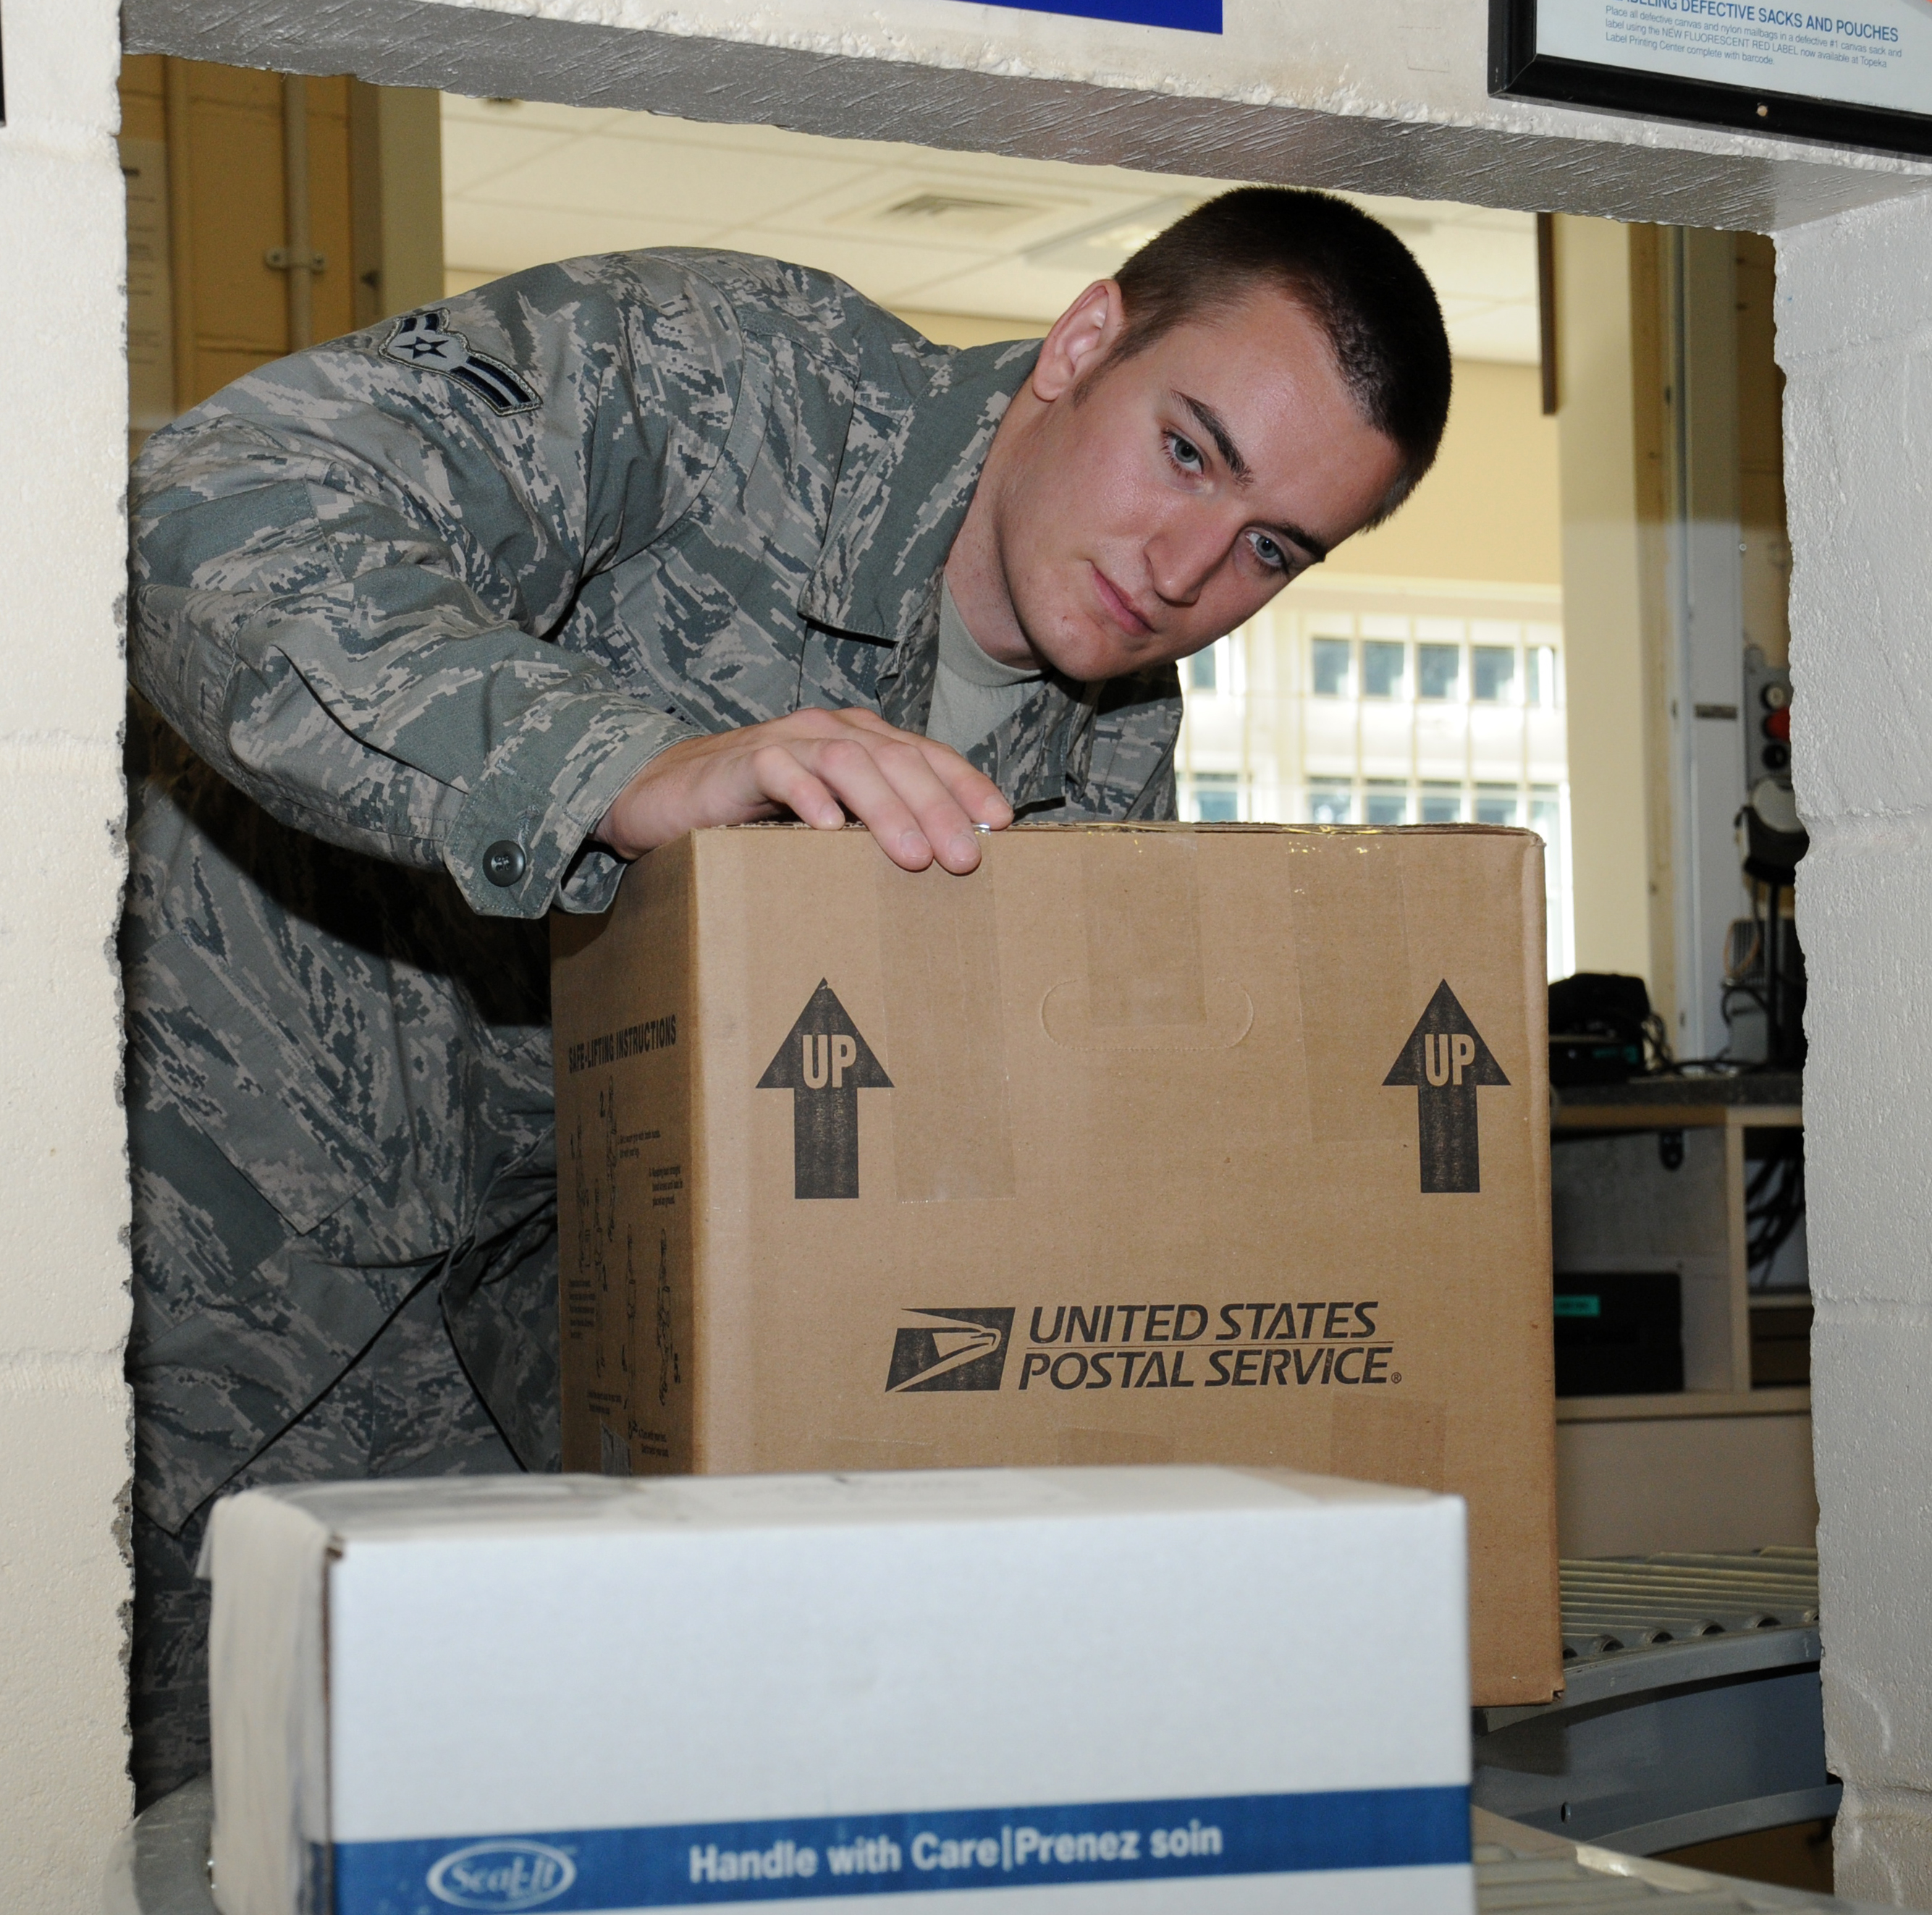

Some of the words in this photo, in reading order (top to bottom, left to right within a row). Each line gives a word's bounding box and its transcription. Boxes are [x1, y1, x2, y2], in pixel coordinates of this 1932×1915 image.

[1606, 5, 1627, 18] Place
[1629, 10, 1638, 19] all
[1640, 11, 1673, 25] defective
[1674, 17, 1701, 29] canvas
[1704, 22, 1718, 31] and
[1721, 25, 1742, 35] nylon
[1744, 27, 1778, 41] mailbags
[1780, 31, 1787, 41] in
[1795, 33, 1828, 46] defective
[1830, 38, 1838, 48] #1
[1841, 42, 1866, 53] canvas
[1869, 45, 1886, 55] sack
[1888, 48, 1902, 58] and
[1606, 19, 1624, 30] label
[1626, 22, 1646, 35] using
[1648, 25, 1660, 35] the
[1662, 28, 1682, 38] NEW
[1684, 31, 1750, 48] FLUORESCENT
[1752, 40, 1771, 51] RED
[1772, 43, 1798, 55] LABEL
[1801, 48, 1816, 58] now
[1818, 50, 1849, 63] available
[1851, 55, 1858, 64] at
[1860, 55, 1887, 68] Topeka
[1682, 0, 1755, 21] DEFECTIVE
[1758, 7, 1802, 28] SACKS
[1806, 15, 1833, 33] AND
[1836, 20, 1899, 42] POUCHES
[1606, 32, 1627, 43] Label
[1629, 35, 1657, 50] Printing
[1660, 41, 1685, 52] Center
[1687, 46, 1722, 58] complete
[1724, 51, 1740, 60] with
[1742, 53, 1775, 65] barcode.
[569, 1033, 614, 1074] SAFE-LIFTING
[616, 1014, 677, 1060] INSTRUCTIONS
[803, 1034, 857, 1088] UP
[1425, 1034, 1475, 1086] UP
[1030, 1303, 1208, 1344] UNITED
[1215, 1301, 1379, 1340] STATES
[1018, 1350, 1194, 1390] POSTAL
[688, 1839, 818, 1883] Handle
[826, 1833, 903, 1876] with
[1150, 1817, 1223, 1859] soin
